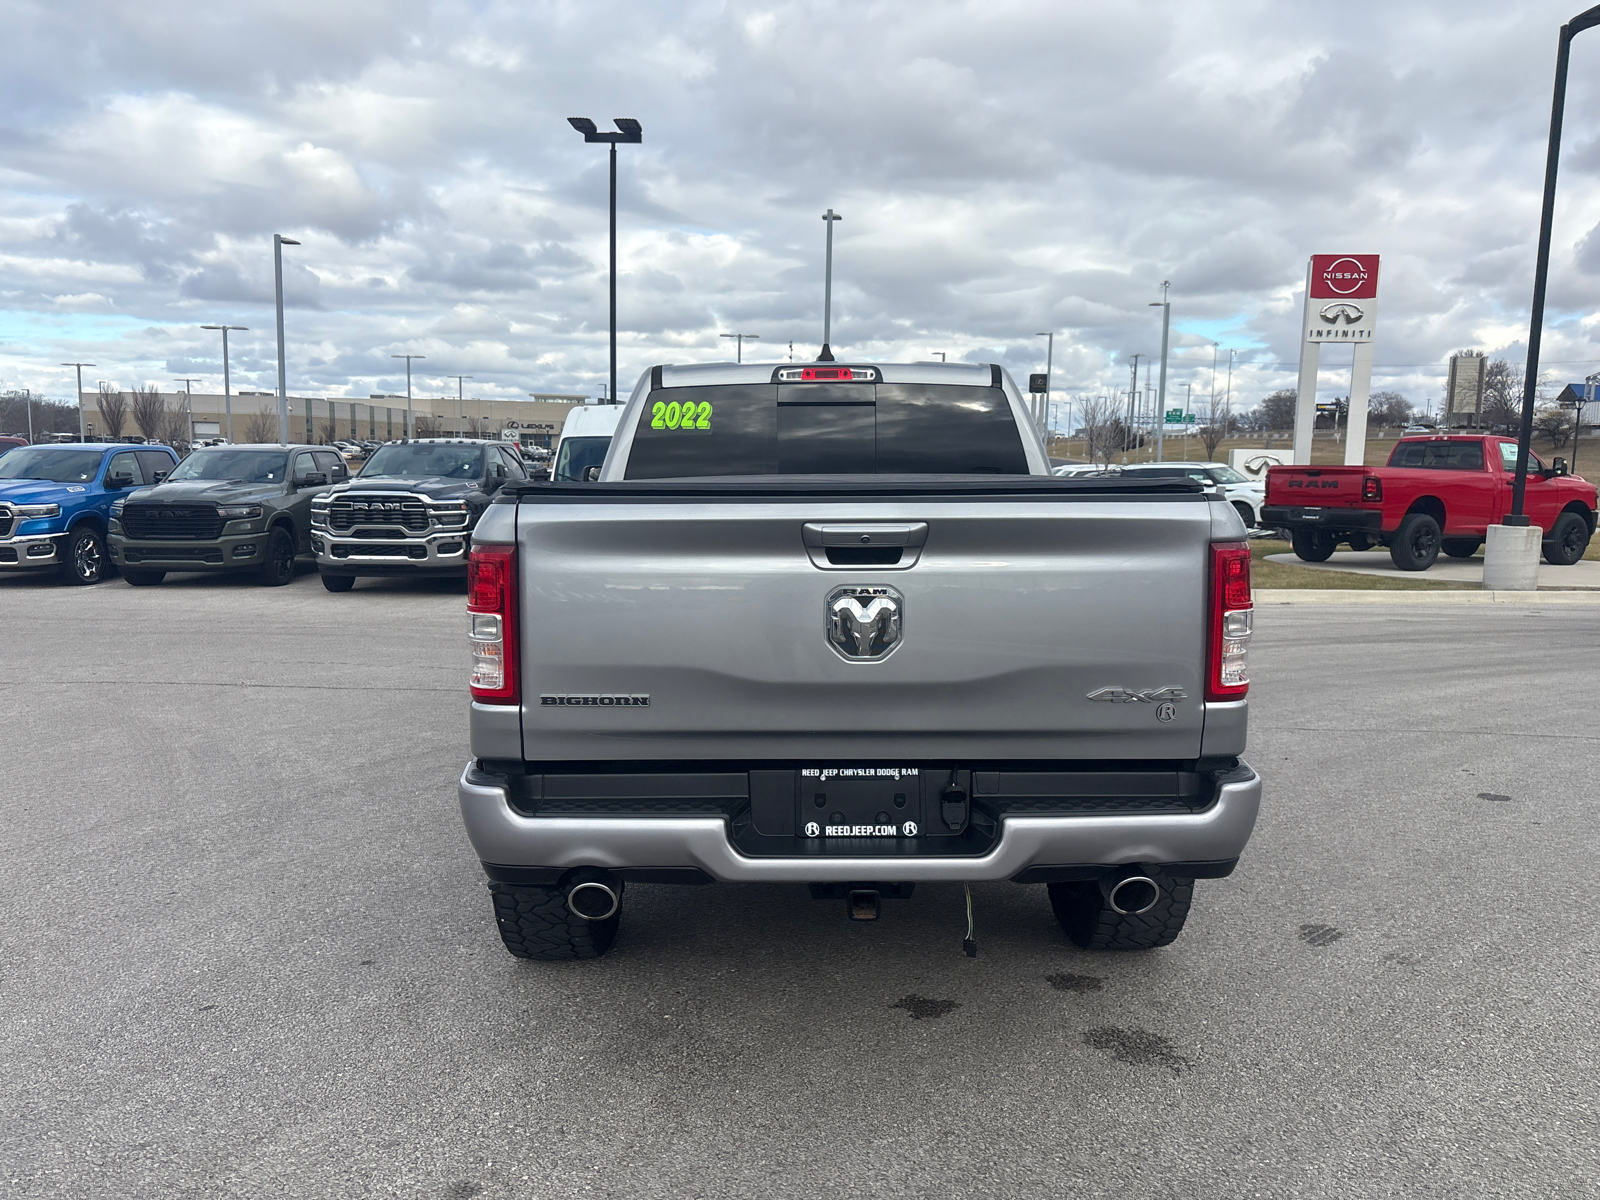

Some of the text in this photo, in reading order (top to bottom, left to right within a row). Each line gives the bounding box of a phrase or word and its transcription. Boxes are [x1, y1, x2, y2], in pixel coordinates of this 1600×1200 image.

[1309, 329, 1371, 338] INFINITI
[651, 401, 713, 430] 2022
[1288, 480, 1339, 489] RAM
[353, 502, 401, 510] RAM
[540, 694, 650, 706] BIGHORN
[801, 768, 919, 777] REED JEEP CHRYSLER DODGE RAM
[825, 825, 897, 836] REEDJEEP.COM
